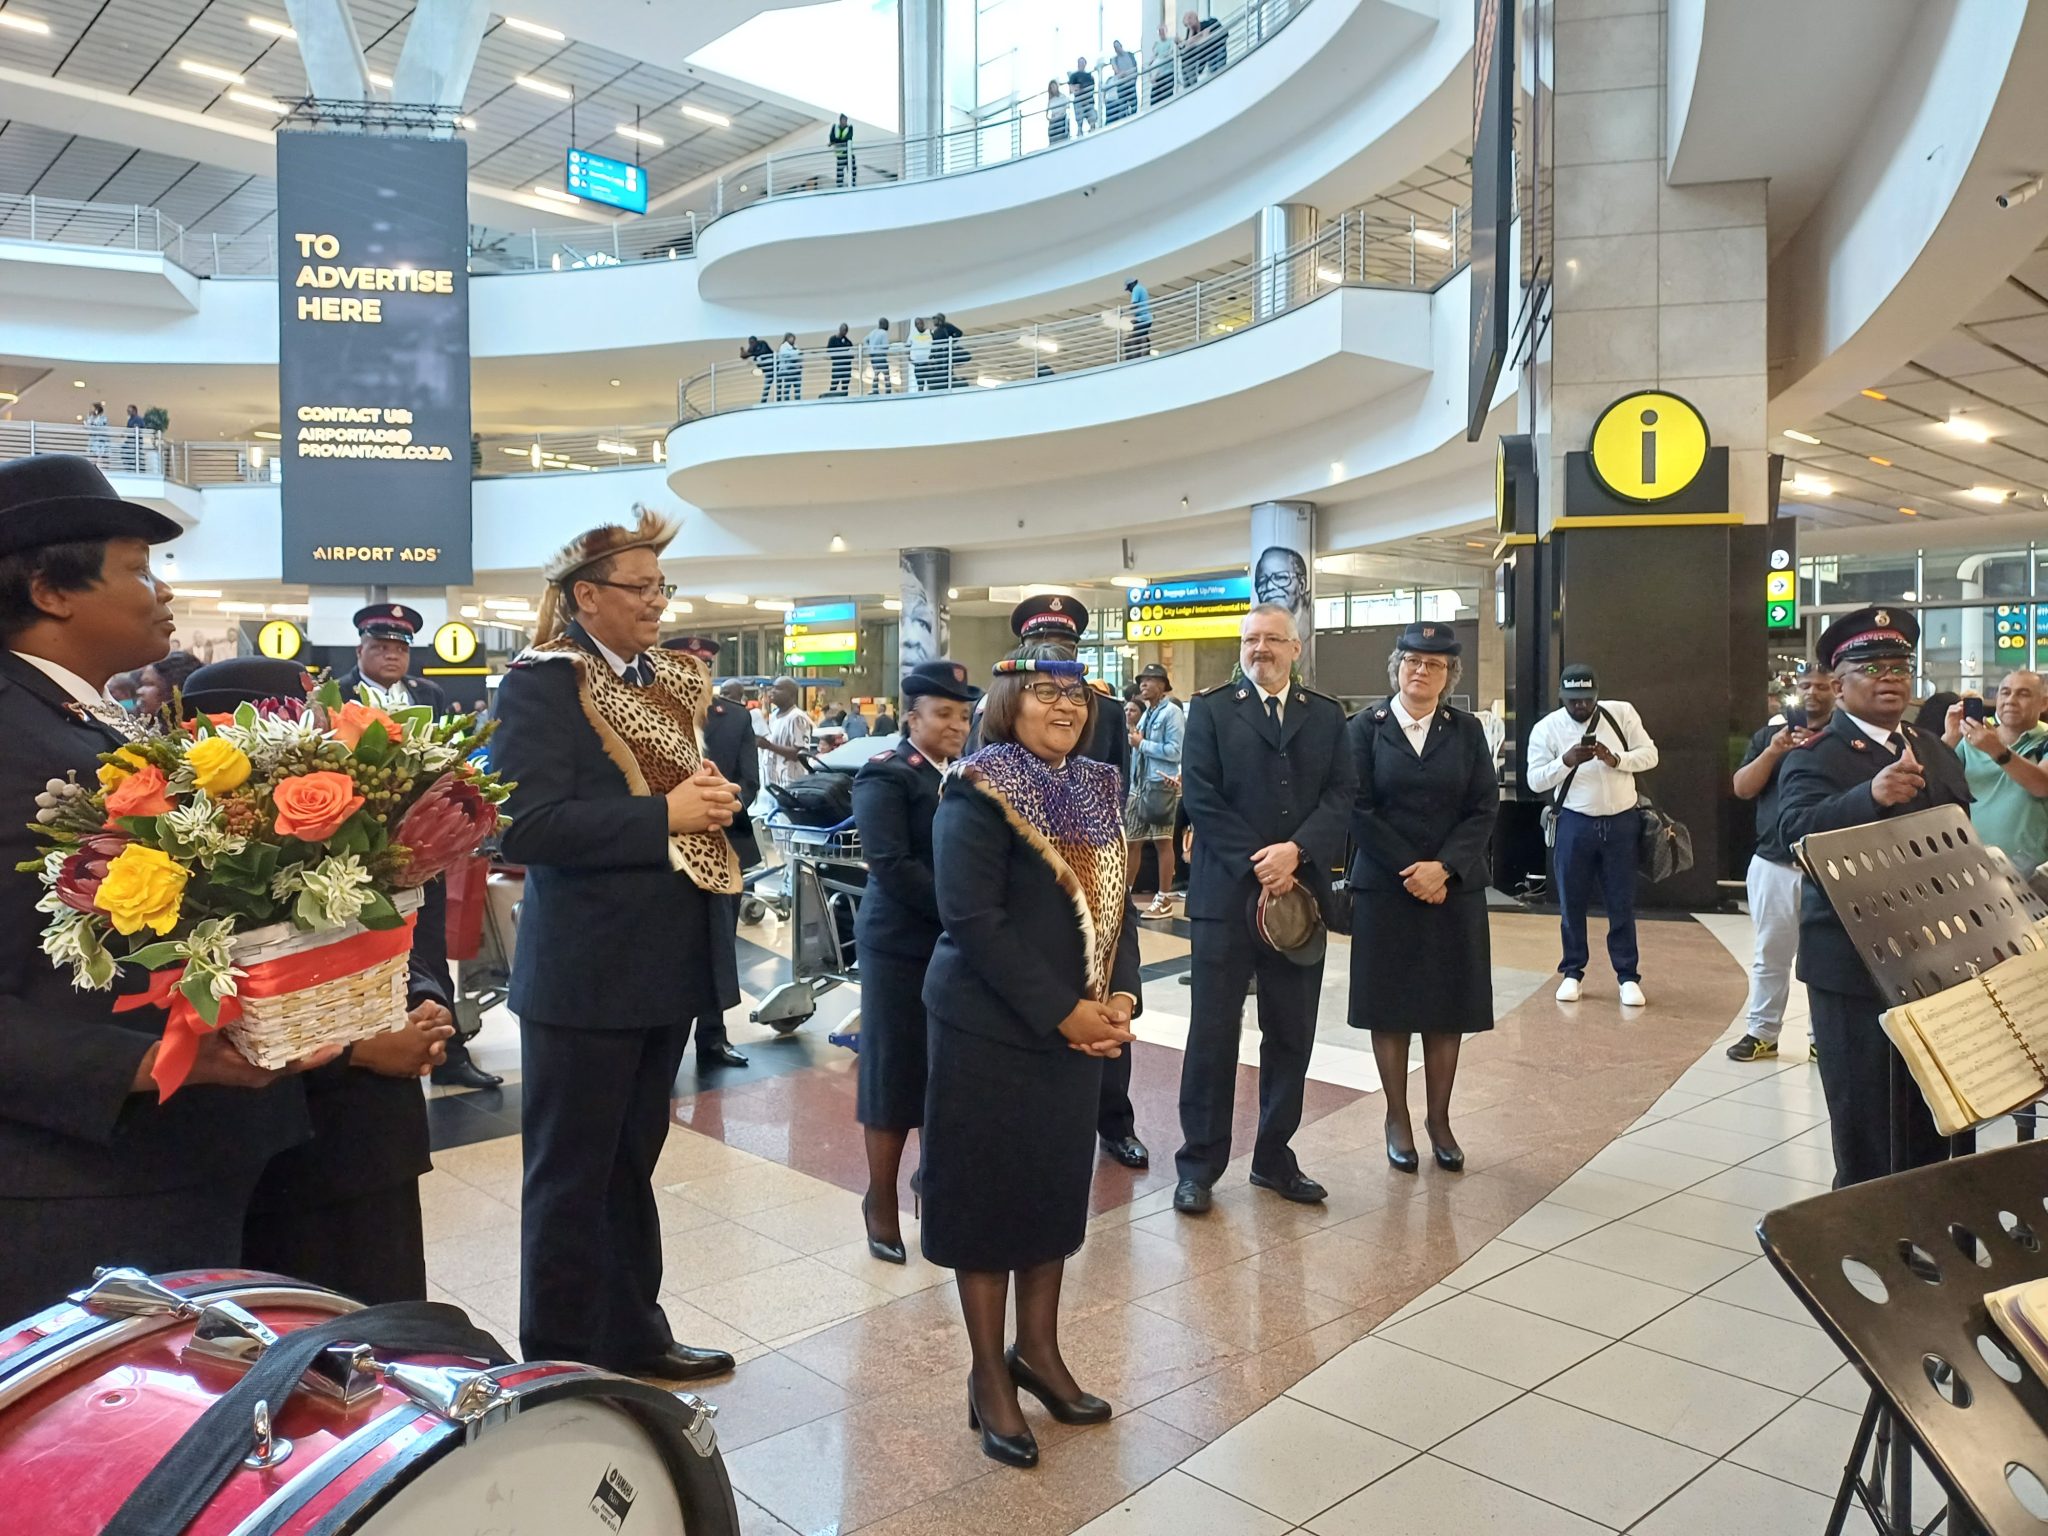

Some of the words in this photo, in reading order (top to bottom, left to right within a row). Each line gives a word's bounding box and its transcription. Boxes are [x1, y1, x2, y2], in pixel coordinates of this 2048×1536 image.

[295, 233, 340, 259] TO
[295, 265, 454, 294] ADVERTISE
[297, 296, 382, 323] HERE
[297, 406, 382, 423] CONTACT
[312, 546, 394, 561] AIRPORT
[1164, 607, 1176, 617] City
[615, 1473, 633, 1499] YAMAHA
